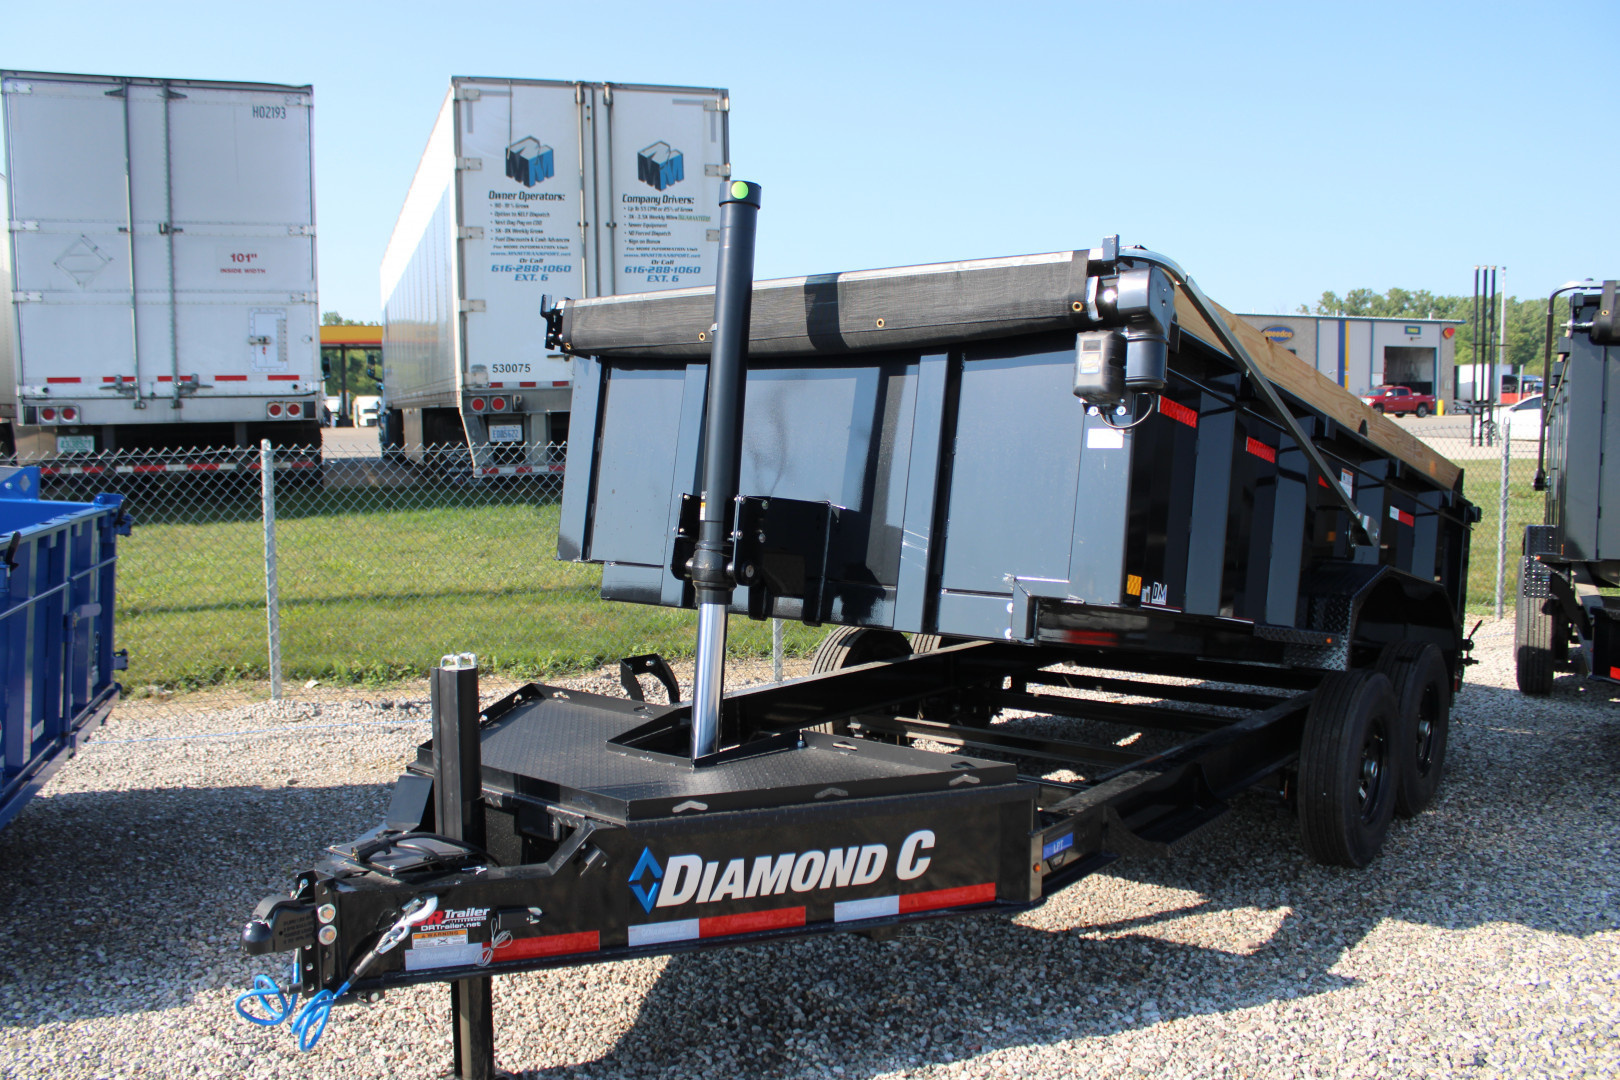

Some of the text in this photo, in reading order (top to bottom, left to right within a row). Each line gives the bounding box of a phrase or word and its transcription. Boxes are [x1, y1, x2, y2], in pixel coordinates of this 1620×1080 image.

[252, 104, 286, 119] H02193
[488, 190, 565, 202] Owner Operators:
[622, 194, 695, 205] Company Drivers:
[515, 273, 549, 281] EXT. 6
[492, 363, 531, 373] 530075
[655, 829, 936, 908] DIAMOND C
[444, 907, 490, 919] Trailer
[421, 921, 481, 932] DRTrailer.net
